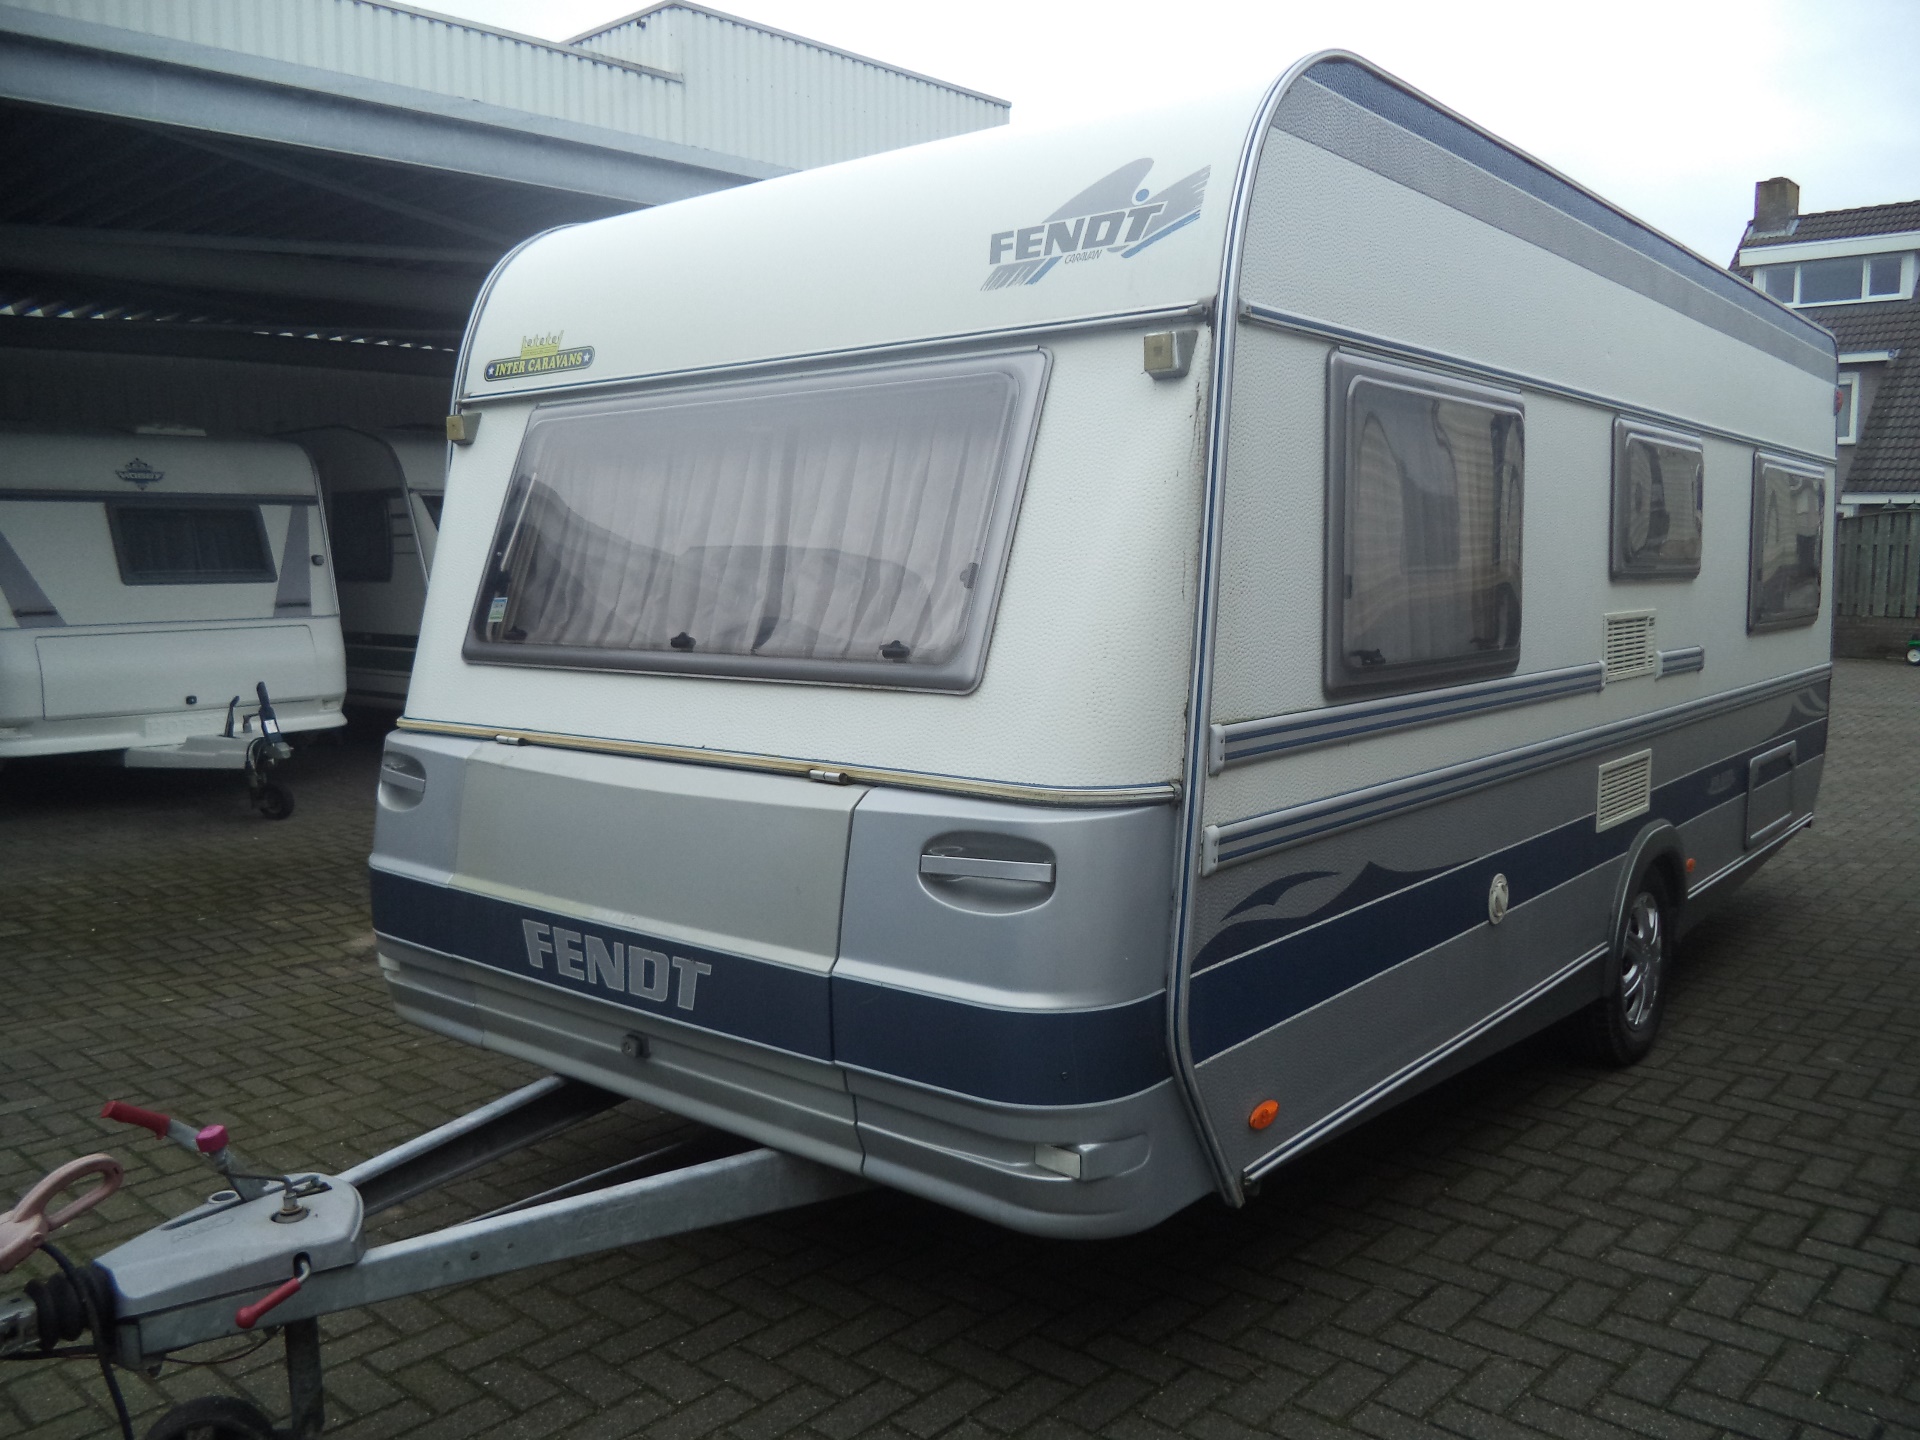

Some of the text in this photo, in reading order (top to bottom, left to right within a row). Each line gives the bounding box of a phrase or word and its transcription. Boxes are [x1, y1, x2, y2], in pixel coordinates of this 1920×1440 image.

[989, 204, 1165, 265] FENDT
[495, 352, 583, 376] INTER CARAVANS
[521, 918, 712, 1011] FENDT
